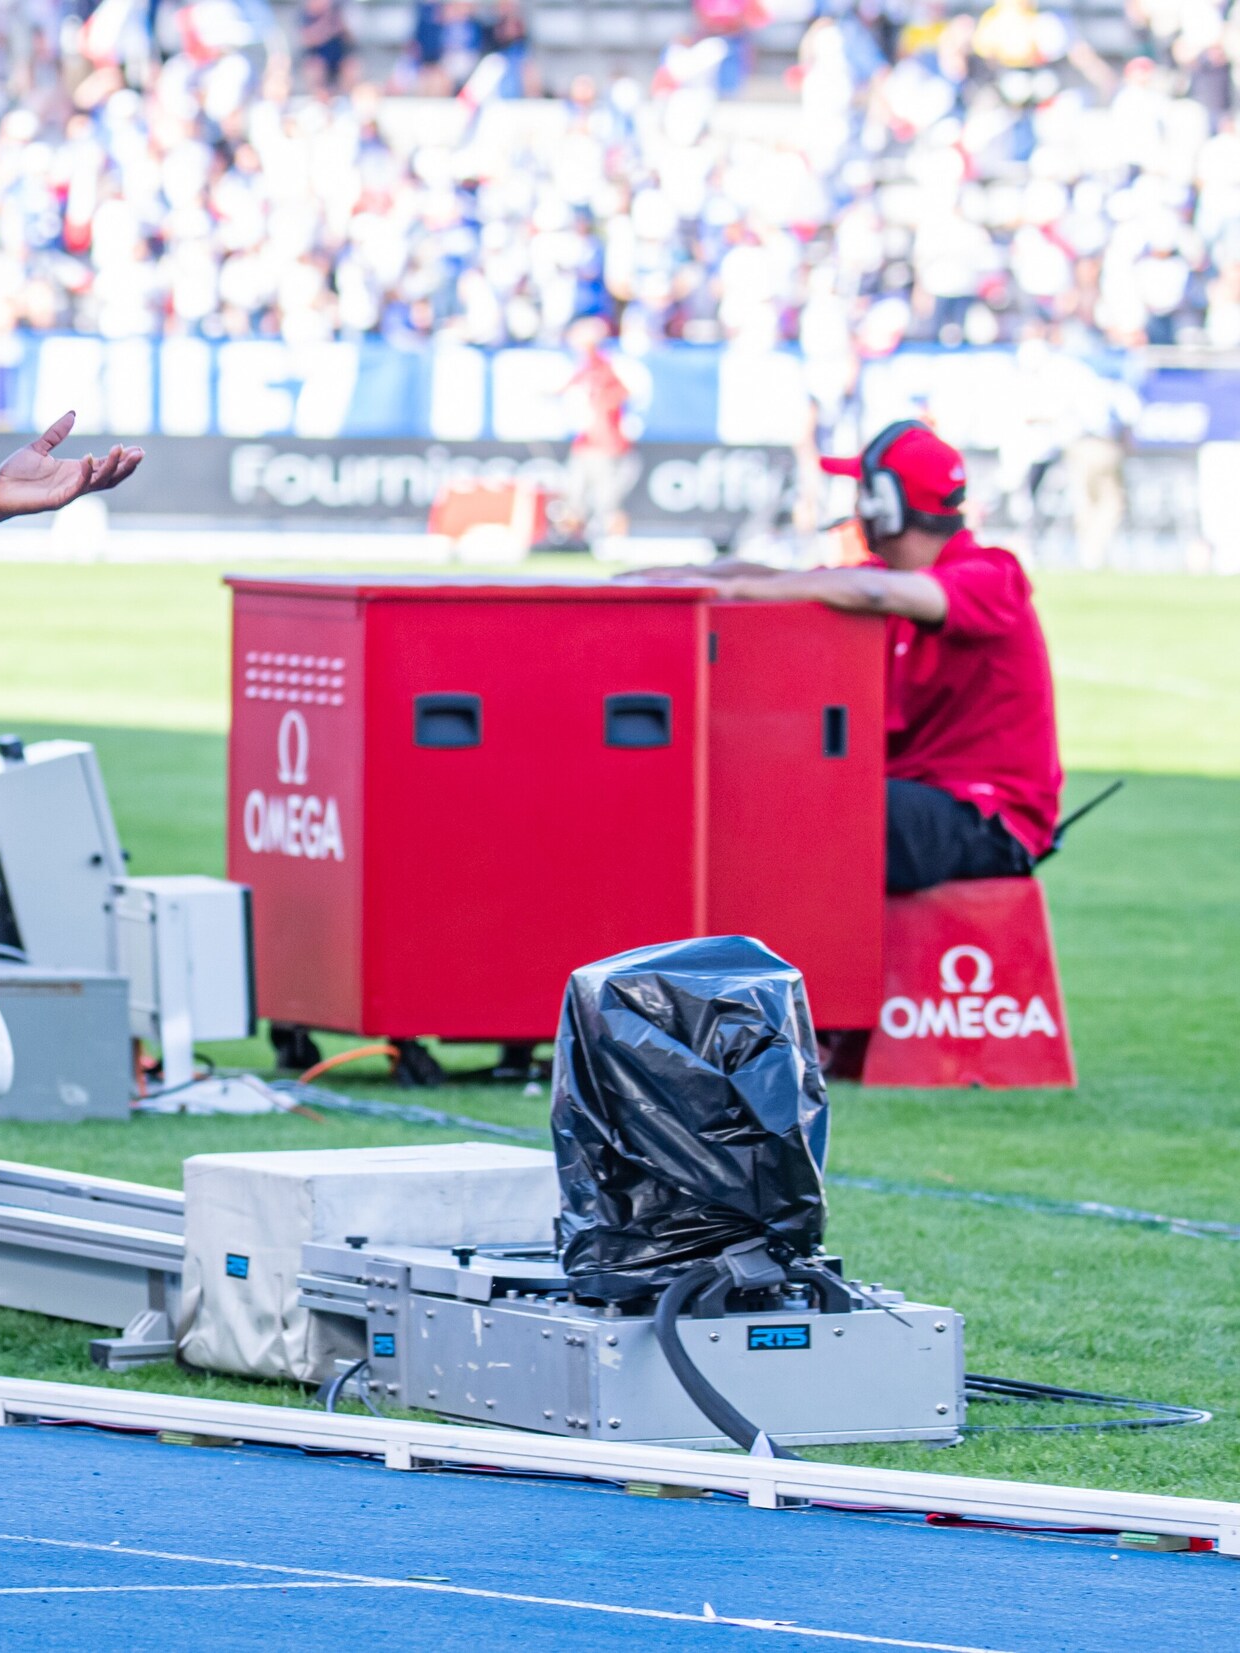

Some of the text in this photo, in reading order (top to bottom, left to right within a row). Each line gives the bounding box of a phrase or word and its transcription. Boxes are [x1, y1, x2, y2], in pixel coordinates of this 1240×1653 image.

[244, 789, 344, 862] OMEGA
[880, 995, 1058, 1039] OMEGA
[750, 1327, 808, 1347] RTS
